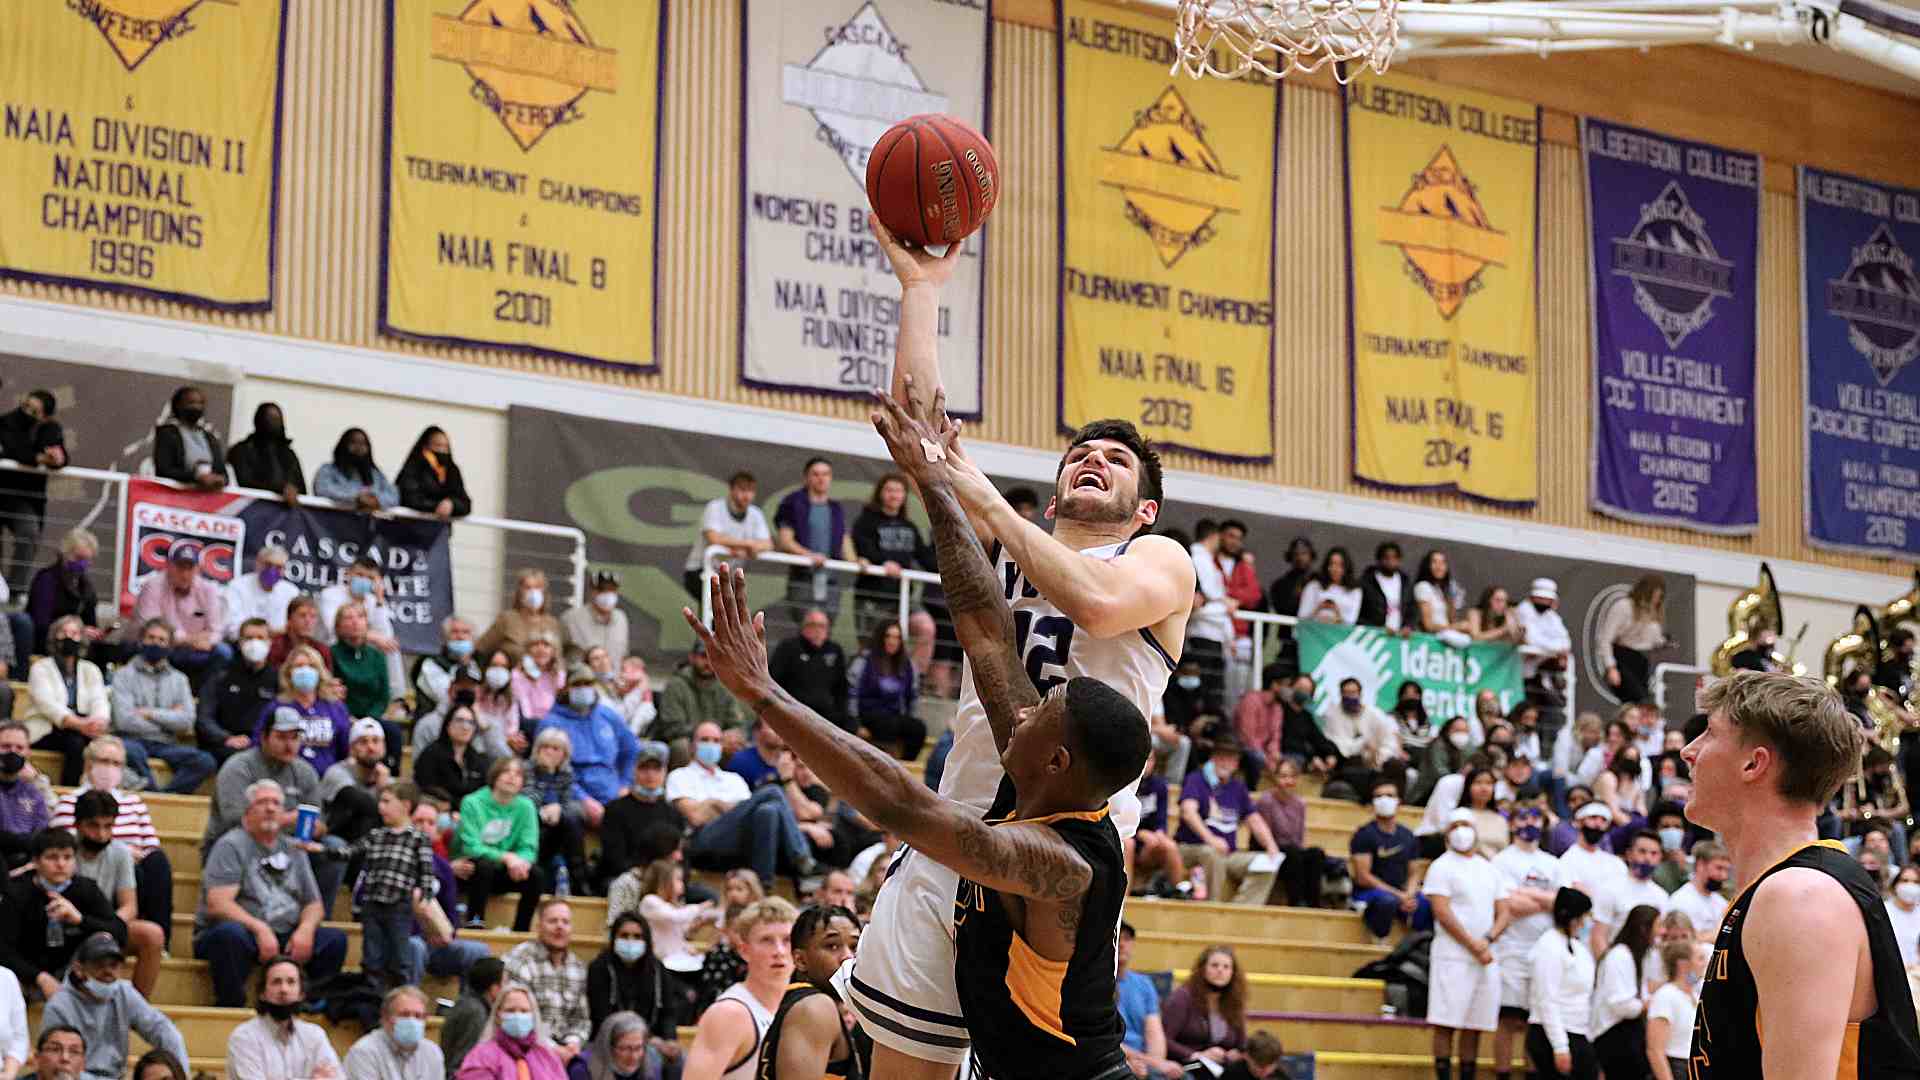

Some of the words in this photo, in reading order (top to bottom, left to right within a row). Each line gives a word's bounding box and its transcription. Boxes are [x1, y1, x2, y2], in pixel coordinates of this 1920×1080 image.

[824, 23, 910, 62] CASCADE
[1350, 81, 1451, 128] ALBERTSON
[1458, 103, 1538, 146] COLLEGE
[5, 104, 74, 147] NAIA
[93, 117, 212, 168] DIVISION
[223, 139, 245, 175] II
[1587, 127, 1682, 174] ALBERTSON
[1687, 148, 1758, 187] COLLEGE
[53, 154, 193, 208] NATIONAL
[406, 155, 528, 195] TOURNAMENT
[539, 178, 642, 216] CHAMPIONS
[42, 193, 202, 249] CHAMPIONS
[753, 194, 837, 229] WOMENS
[91, 238, 154, 280] 1996
[437, 232, 495, 271] NAIA
[507, 243, 578, 285] FINAL
[494, 290, 552, 328] 2001
[774, 280, 828, 315] NAIA
[838, 288, 901, 325] DIVISI
[1065, 267, 1170, 311] TOURNAMENT
[1178, 289, 1274, 326] CHAMPIONS
[1099, 347, 1146, 381] NAIA
[1153, 353, 1207, 391] FINAL
[1216, 366, 1235, 395] 16
[1621, 350, 1728, 394] VOLLEYBALL
[1385, 395, 1428, 425] NAIA
[1640, 383, 1746, 426] TOURNAMENT
[1629, 430, 1664, 454] NAIA
[1639, 454, 1712, 484] CHAMPIONS
[1401, 640, 1481, 684] Idaho
